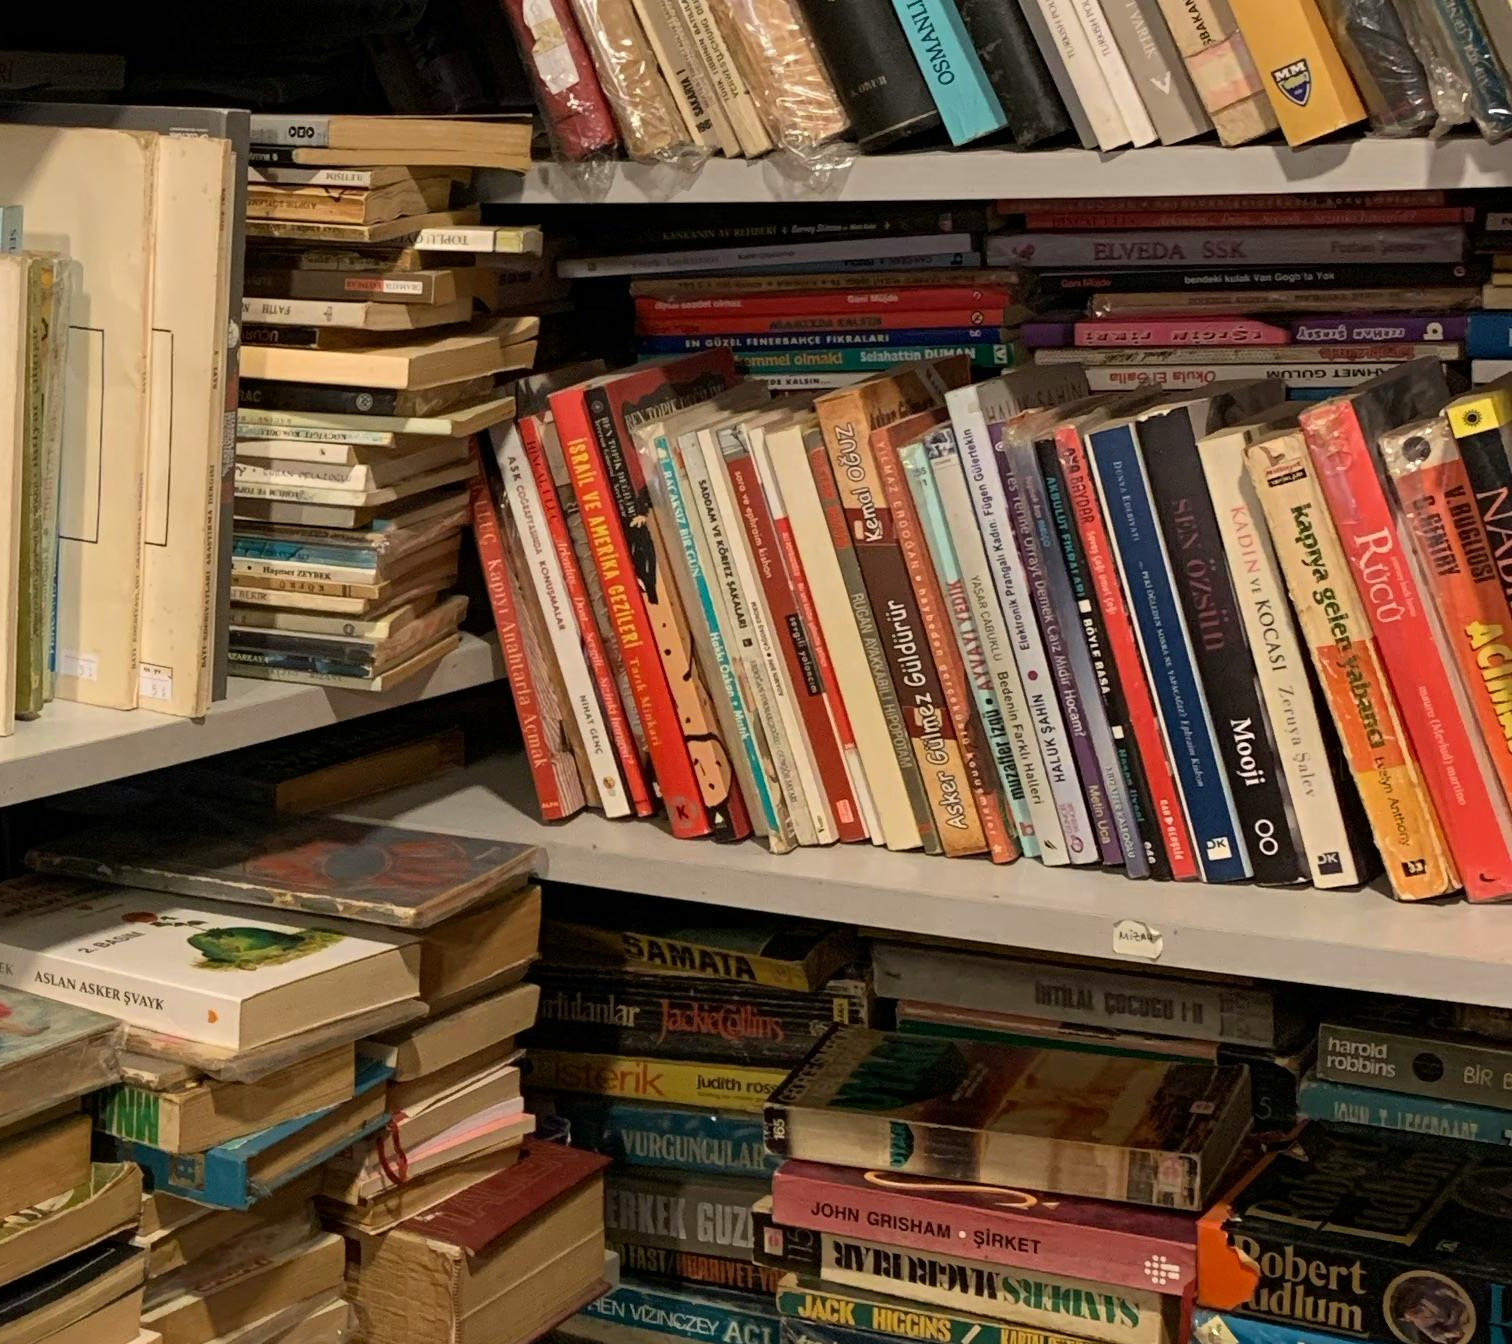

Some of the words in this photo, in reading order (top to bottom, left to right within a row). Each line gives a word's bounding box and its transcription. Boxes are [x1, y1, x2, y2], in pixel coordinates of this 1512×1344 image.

[1094, 242, 1186, 261] ELVEDA
[1202, 241, 1247, 259] SSK
[1231, 505, 1262, 577] KADIN
[1247, 576, 1266, 597] VE
[1252, 596, 1287, 672] KOCASI
[486, 558, 509, 615] Kapıyı
[500, 615, 532, 708] Anahtarla
[519, 712, 546, 769] Açmak
[1230, 716, 1267, 788] Mooji
[34, 969, 76, 993] ASLAN
[79, 979, 121, 1001] ASKER
[124, 988, 165, 1012] ŞVAYK
[1326, 1036, 1388, 1059] harold
[1326, 1055, 1396, 1079] robbins
[810, 1203, 860, 1223] JOHN
[866, 1211, 951, 1240] GRISHAM
[973, 1229, 1042, 1255] ŞİRKET
[1235, 1234, 1367, 1297] Robert
[798, 1294, 855, 1326] JACK
[871, 1308, 951, 1342] HIGGINS
